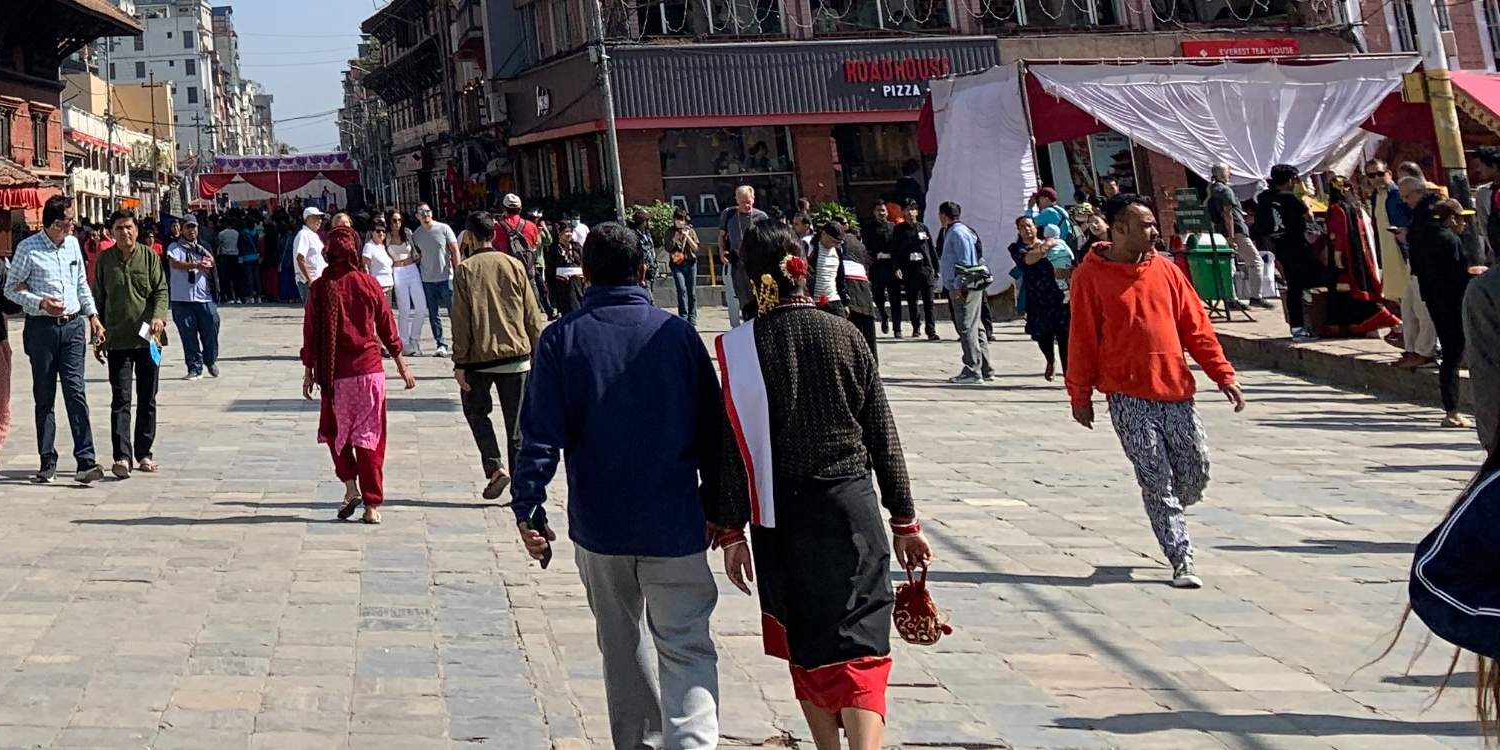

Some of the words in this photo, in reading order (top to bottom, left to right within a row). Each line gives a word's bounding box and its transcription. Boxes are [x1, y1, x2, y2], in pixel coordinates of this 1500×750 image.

[1219, 47, 1250, 56] EVEREST
[1251, 47, 1266, 55] TEA
[1268, 46, 1294, 55] HOUSE
[844, 56, 949, 82] ROADHOUSE
[883, 85, 920, 97] PIZZA
